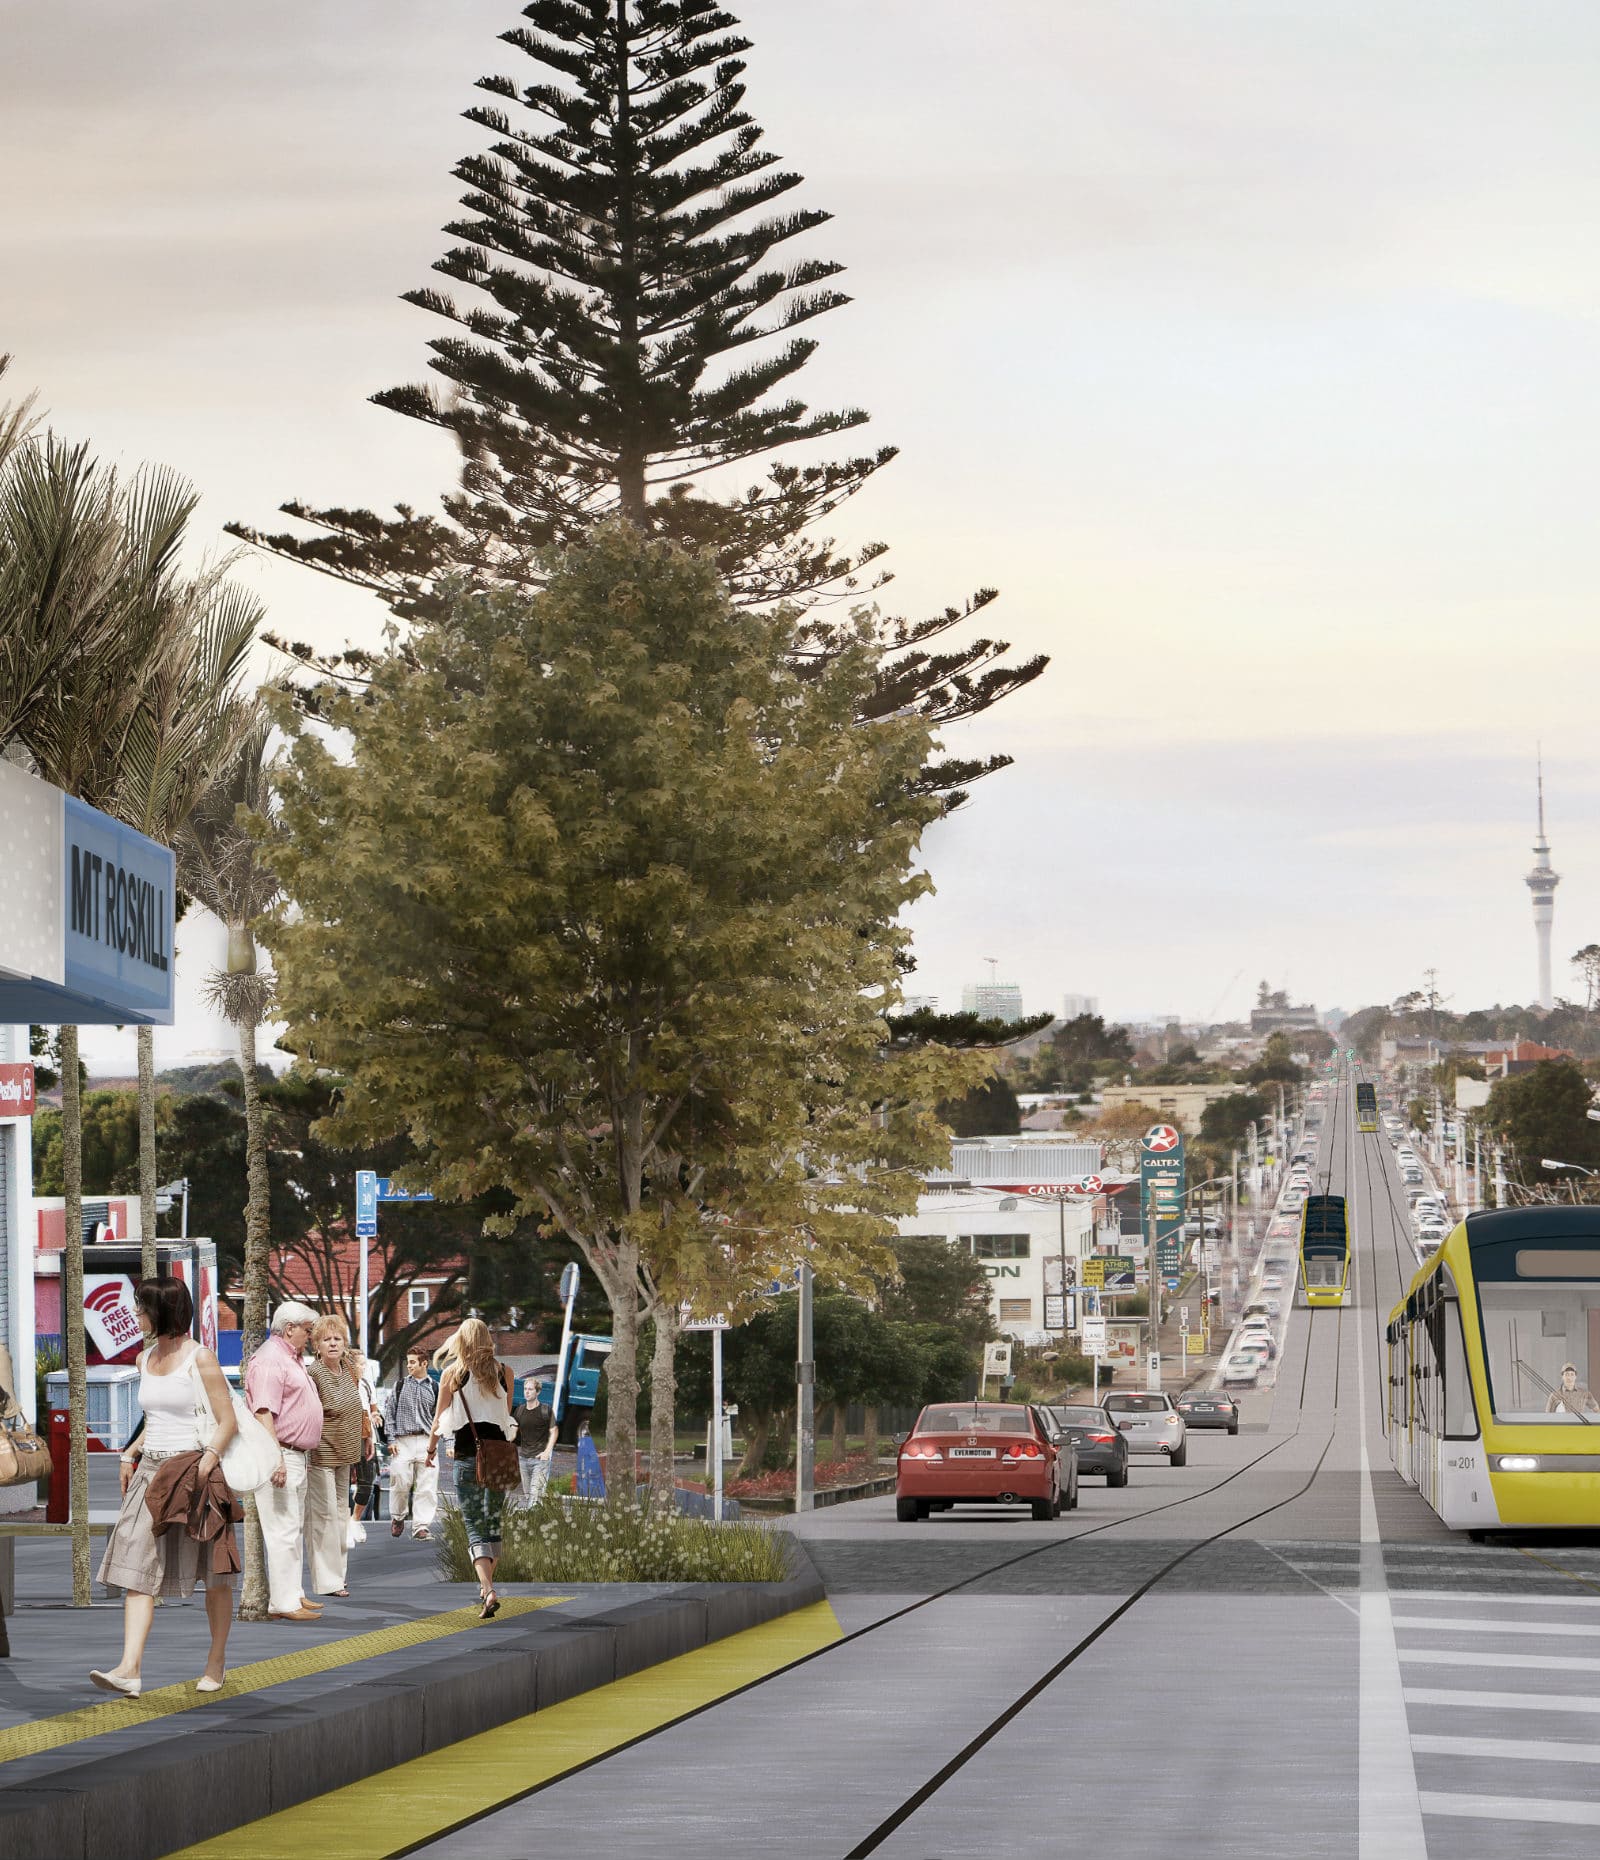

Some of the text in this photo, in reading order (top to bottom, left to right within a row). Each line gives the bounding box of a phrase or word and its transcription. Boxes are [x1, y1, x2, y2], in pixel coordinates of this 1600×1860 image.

[71, 844, 168, 972] MT ROSKILL
[1143, 1159, 1181, 1167] CALTEX
[1028, 1185, 1077, 1195] CALTEX
[101, 1305, 129, 1327] FREE
[114, 1326, 140, 1347] ZONE
[954, 1449, 992, 1457] EVERMOTION
[1458, 1456, 1475, 1469] 201
